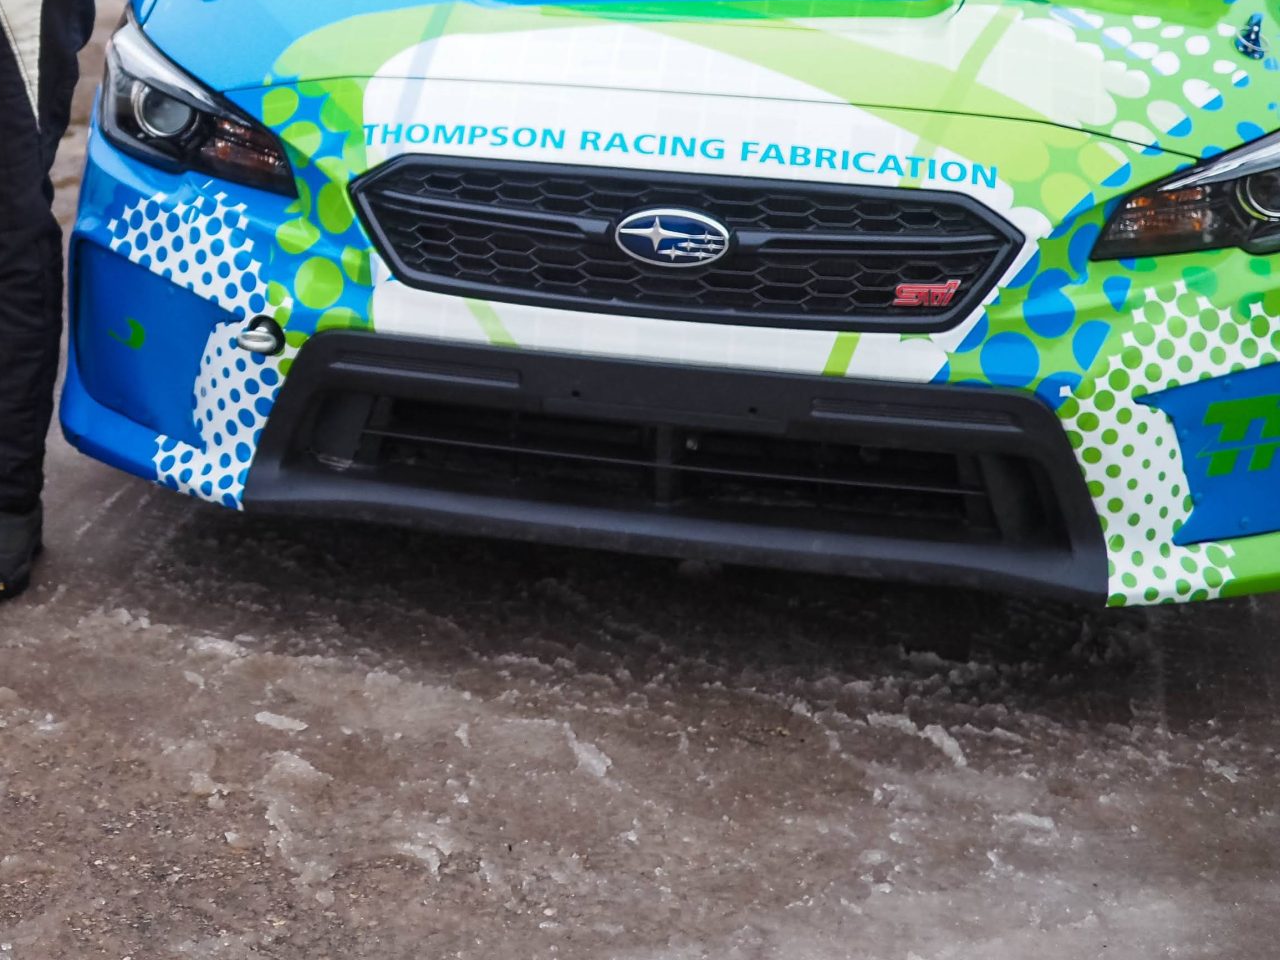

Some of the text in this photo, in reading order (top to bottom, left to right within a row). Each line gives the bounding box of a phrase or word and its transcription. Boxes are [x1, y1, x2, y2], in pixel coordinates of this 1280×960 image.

[362, 123, 998, 189] THOMPSON RACING FABRICATION
